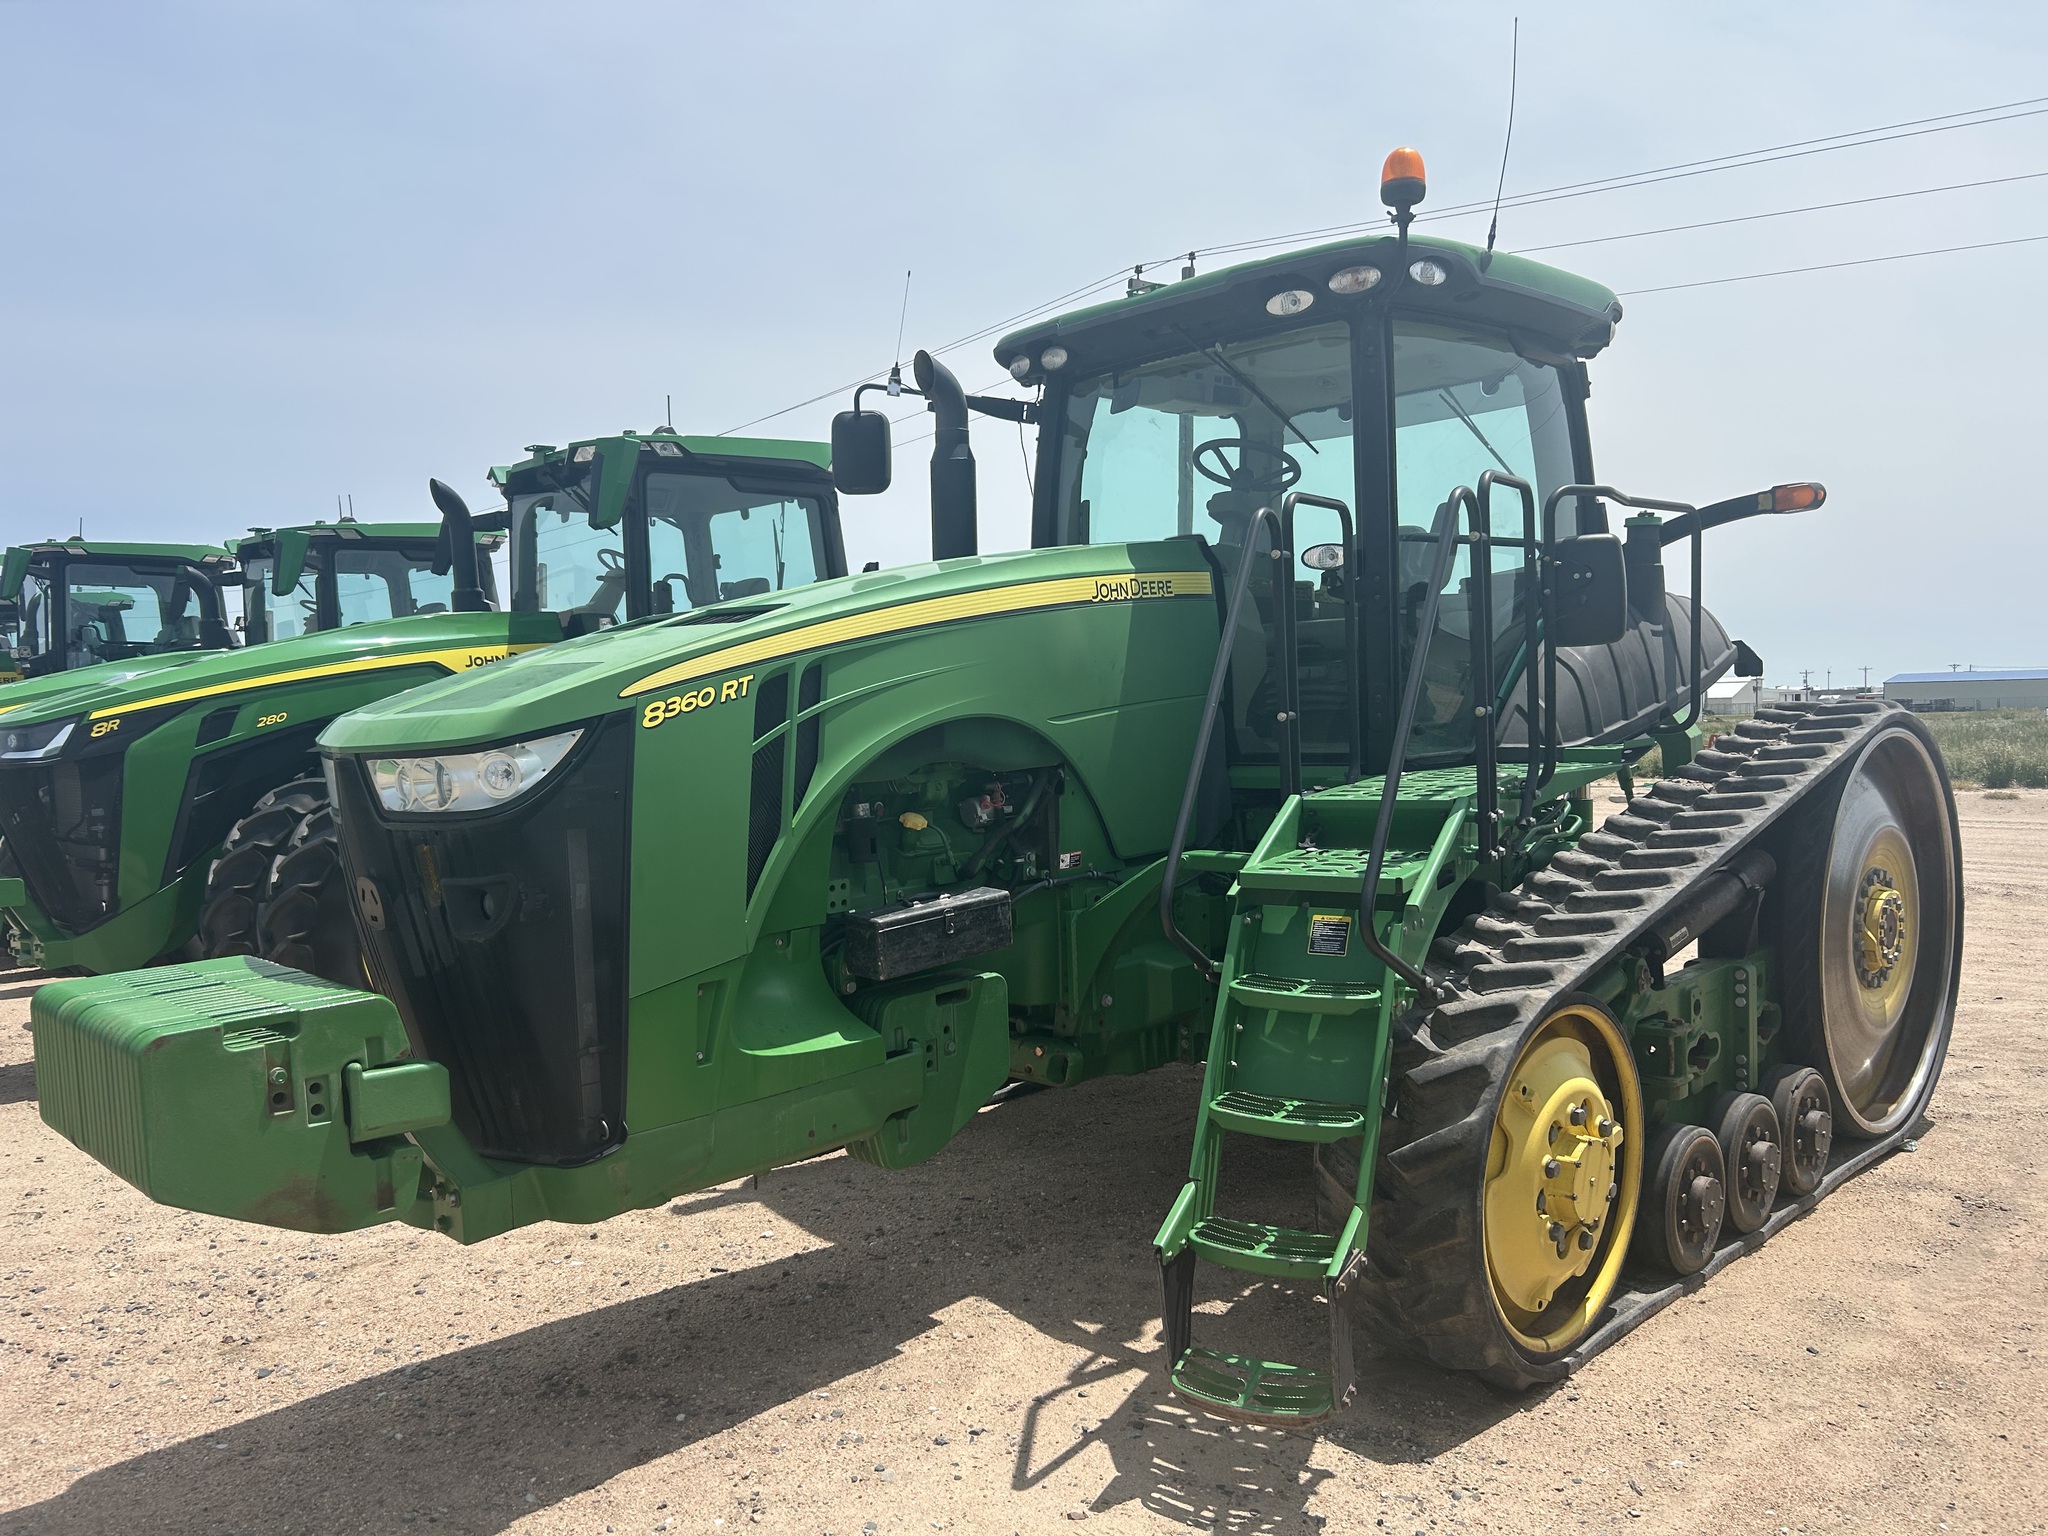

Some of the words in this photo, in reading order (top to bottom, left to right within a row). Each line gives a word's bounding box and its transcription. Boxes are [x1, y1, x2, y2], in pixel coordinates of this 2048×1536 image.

[1092, 580, 1129, 600] JOHN
[1130, 578, 1173, 597] DEERE
[642, 687, 716, 729] 8360
[720, 674, 755, 704] RT
[90, 718, 121, 738] 8R
[256, 712, 288, 728] 280
